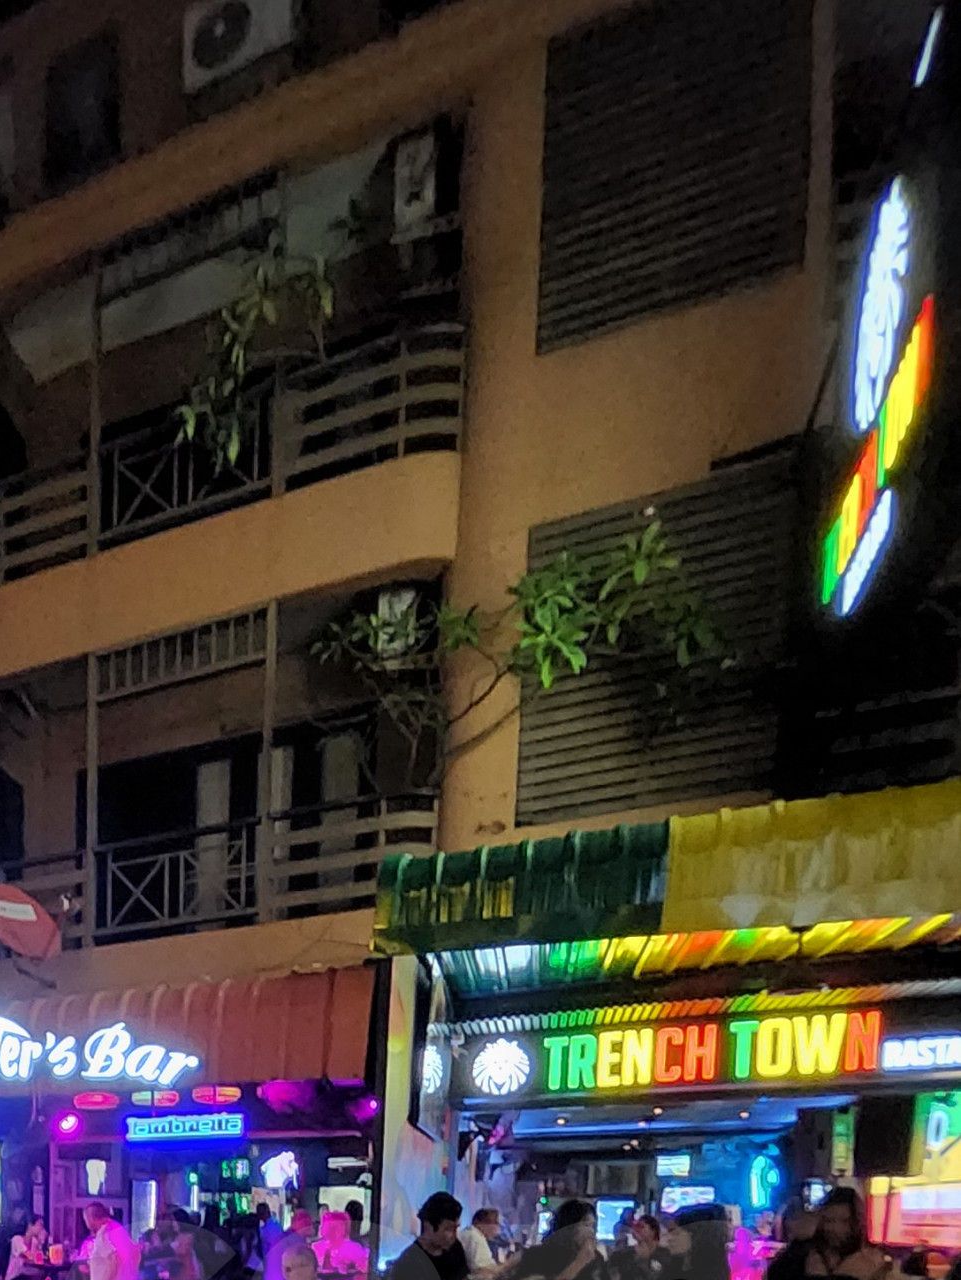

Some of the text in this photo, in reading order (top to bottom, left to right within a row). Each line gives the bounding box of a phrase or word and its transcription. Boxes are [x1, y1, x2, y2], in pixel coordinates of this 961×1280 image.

[81, 1021, 198, 1085] Bar
[543, 1023, 719, 1091] TRENCH
[729, 1010, 882, 1078] TOWN
